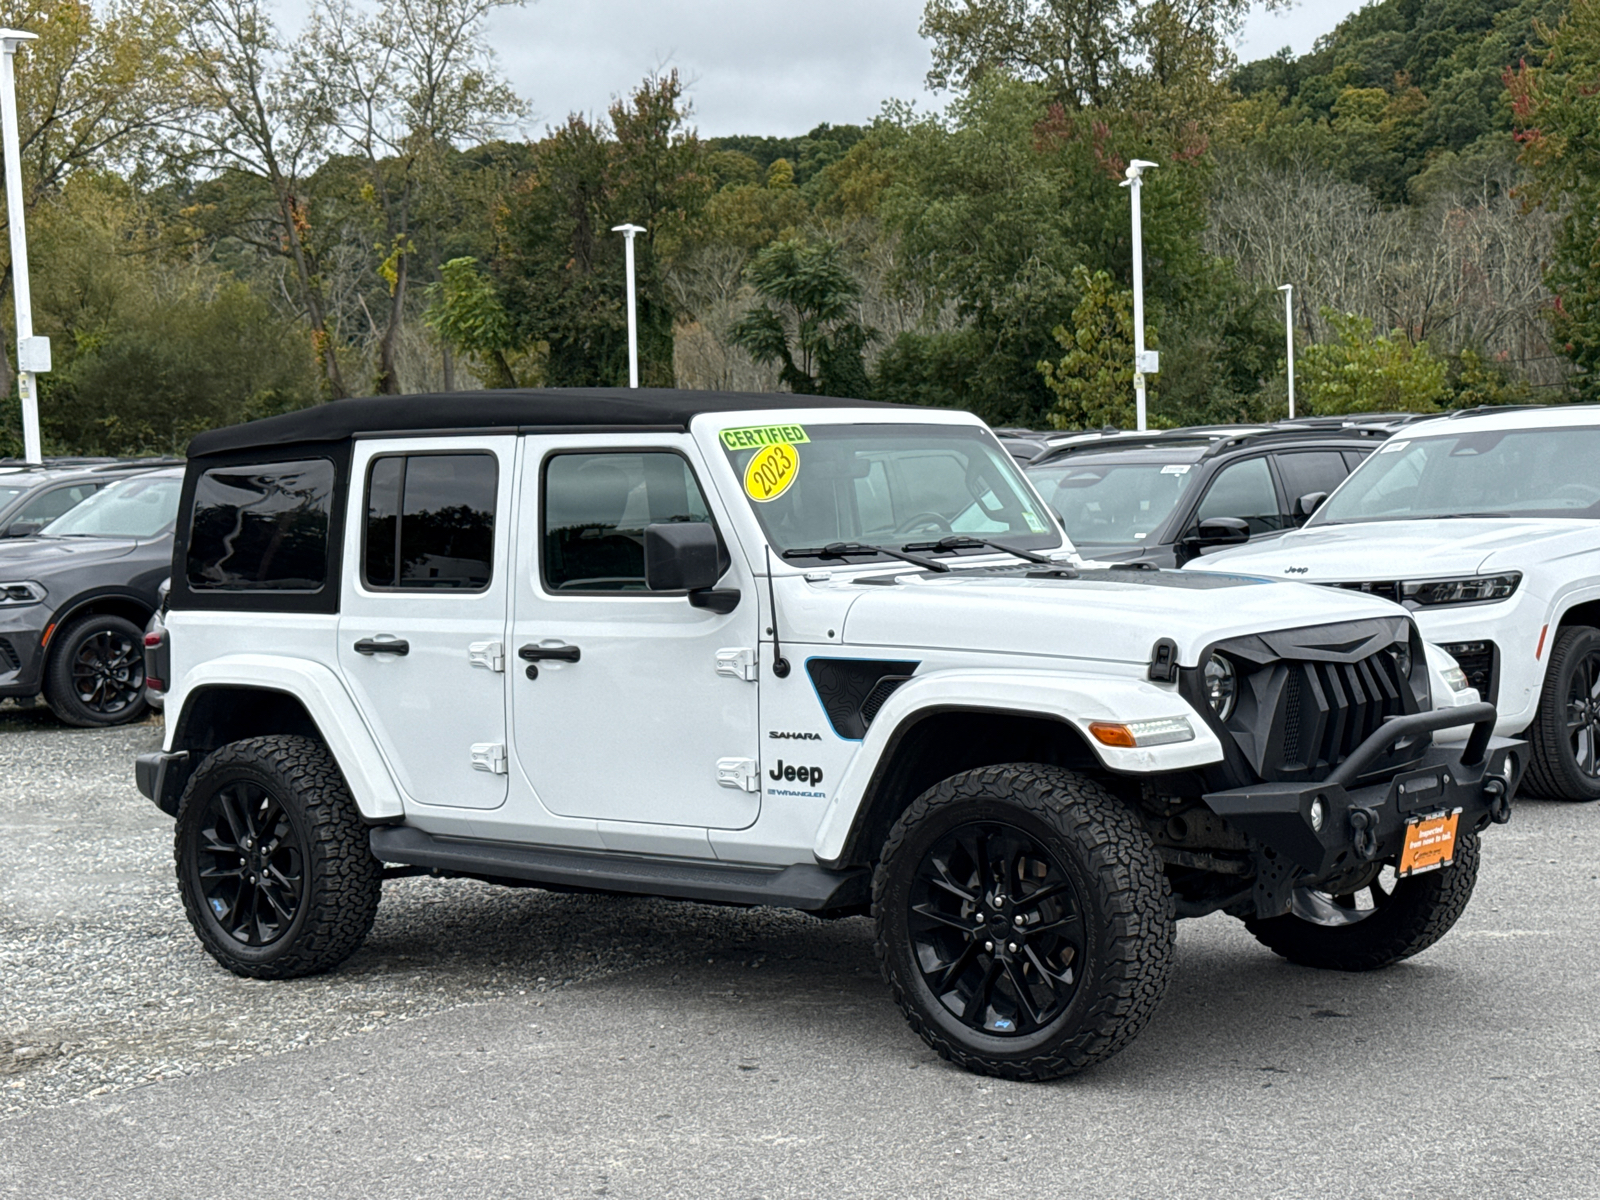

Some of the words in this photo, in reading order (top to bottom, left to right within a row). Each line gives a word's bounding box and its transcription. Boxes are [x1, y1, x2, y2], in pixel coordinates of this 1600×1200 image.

[723, 426, 804, 447] CERTIFIED
[753, 446, 792, 496] 2023
[1284, 565, 1309, 575] Jeep
[768, 730, 823, 741] SAHARA
[769, 759, 823, 788] Jeep
